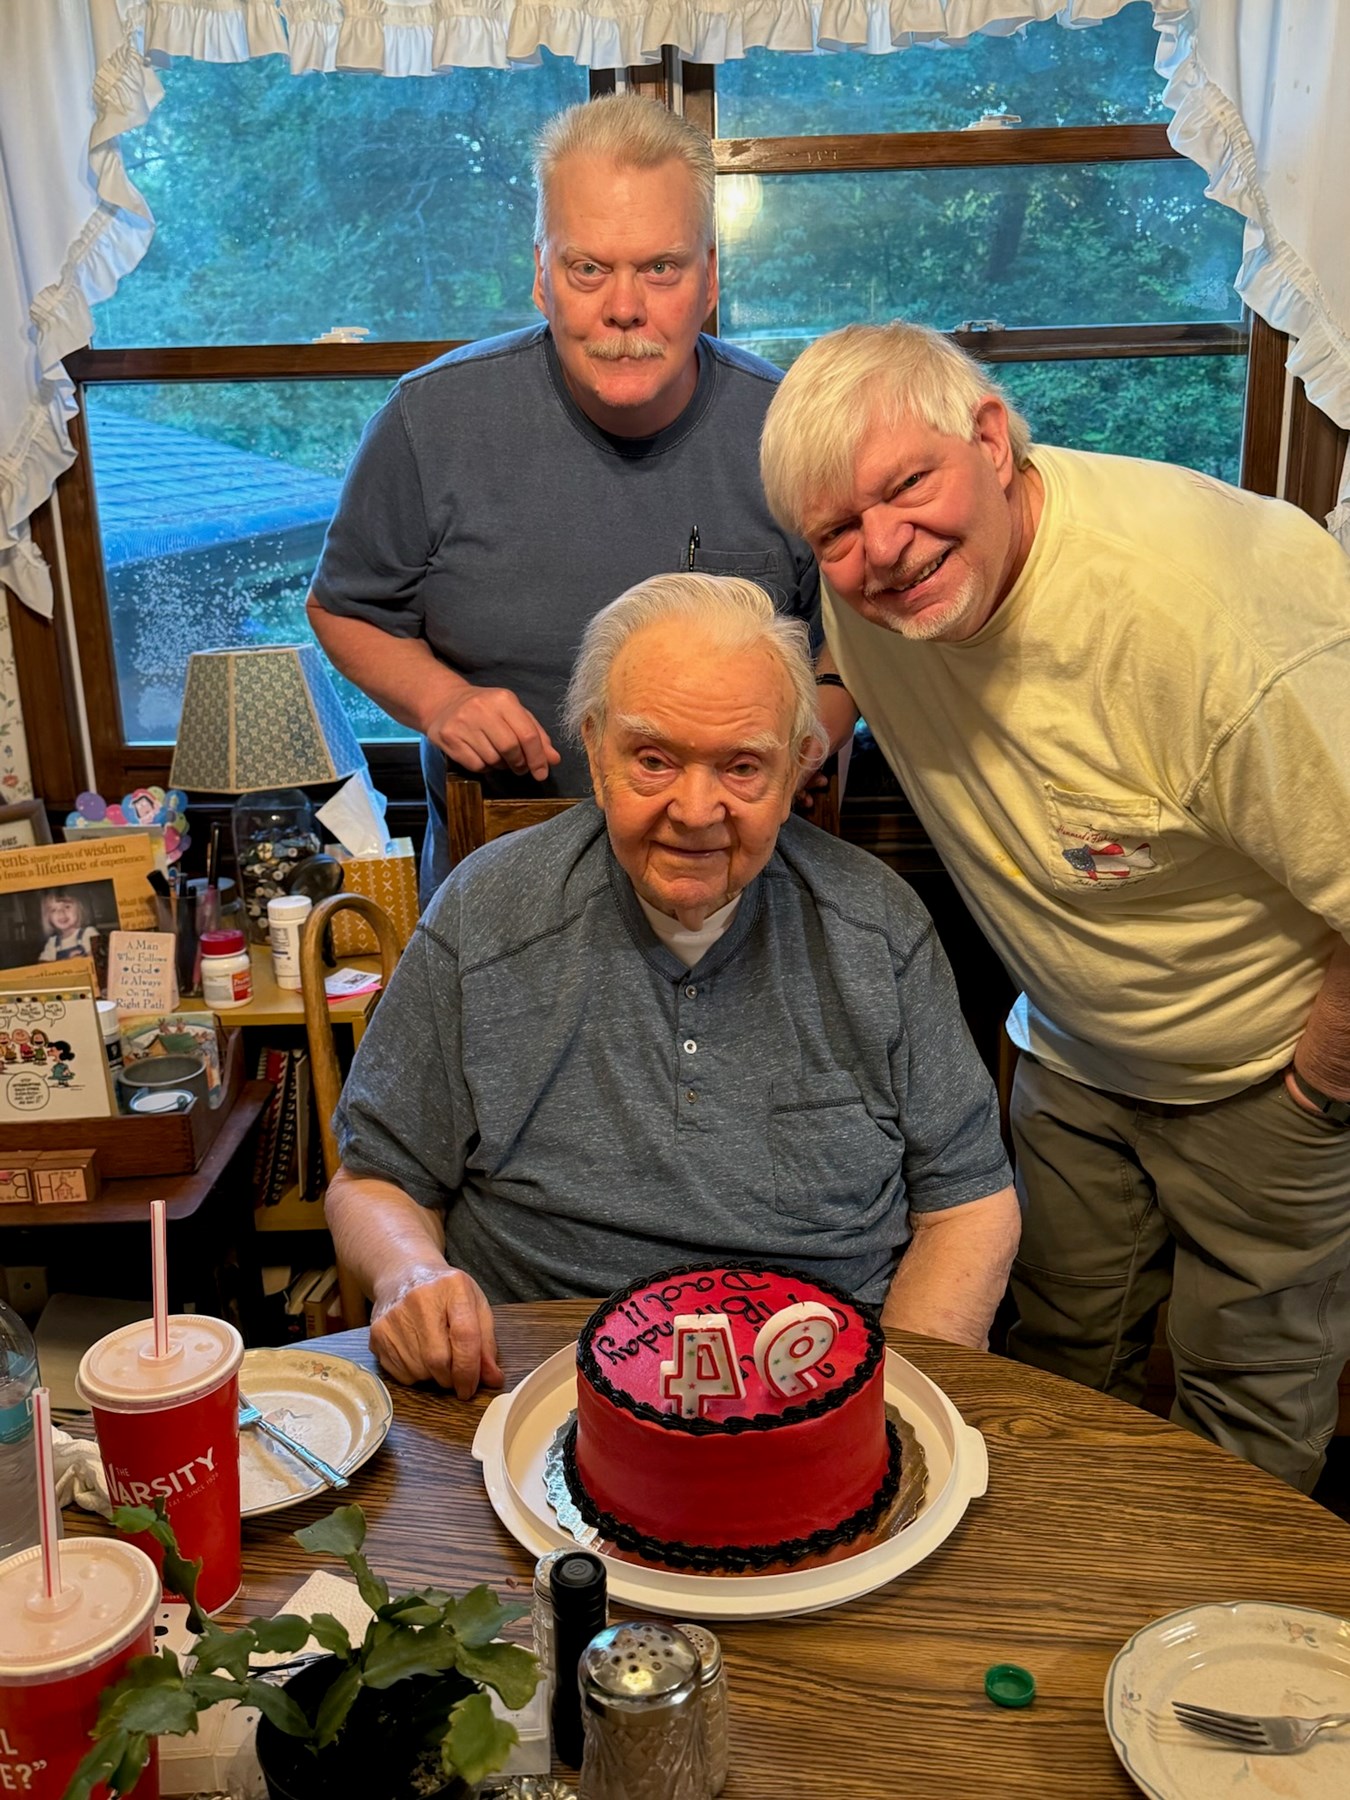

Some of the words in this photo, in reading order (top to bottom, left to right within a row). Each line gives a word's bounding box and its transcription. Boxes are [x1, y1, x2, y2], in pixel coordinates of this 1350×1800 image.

[0, 854, 30, 869] ents
[82, 842, 127, 857] wisdom
[36, 861, 88, 877] lifetime
[127, 940, 134, 950] A
[136, 939, 159, 951] Man
[116, 952, 136, 961] Who
[137, 952, 168, 963] Follows
[131, 963, 153, 975] God
[121, 976, 129, 985] Is
[130, 975, 162, 988] Always
[126, 988, 139, 997] On
[140, 988, 155, 998] The
[116, 997, 140, 1009] Right
[143, 998, 165, 1009] Path
[105, 1446, 216, 1506] VARSITY
[115, 1466, 131, 1477] THE
